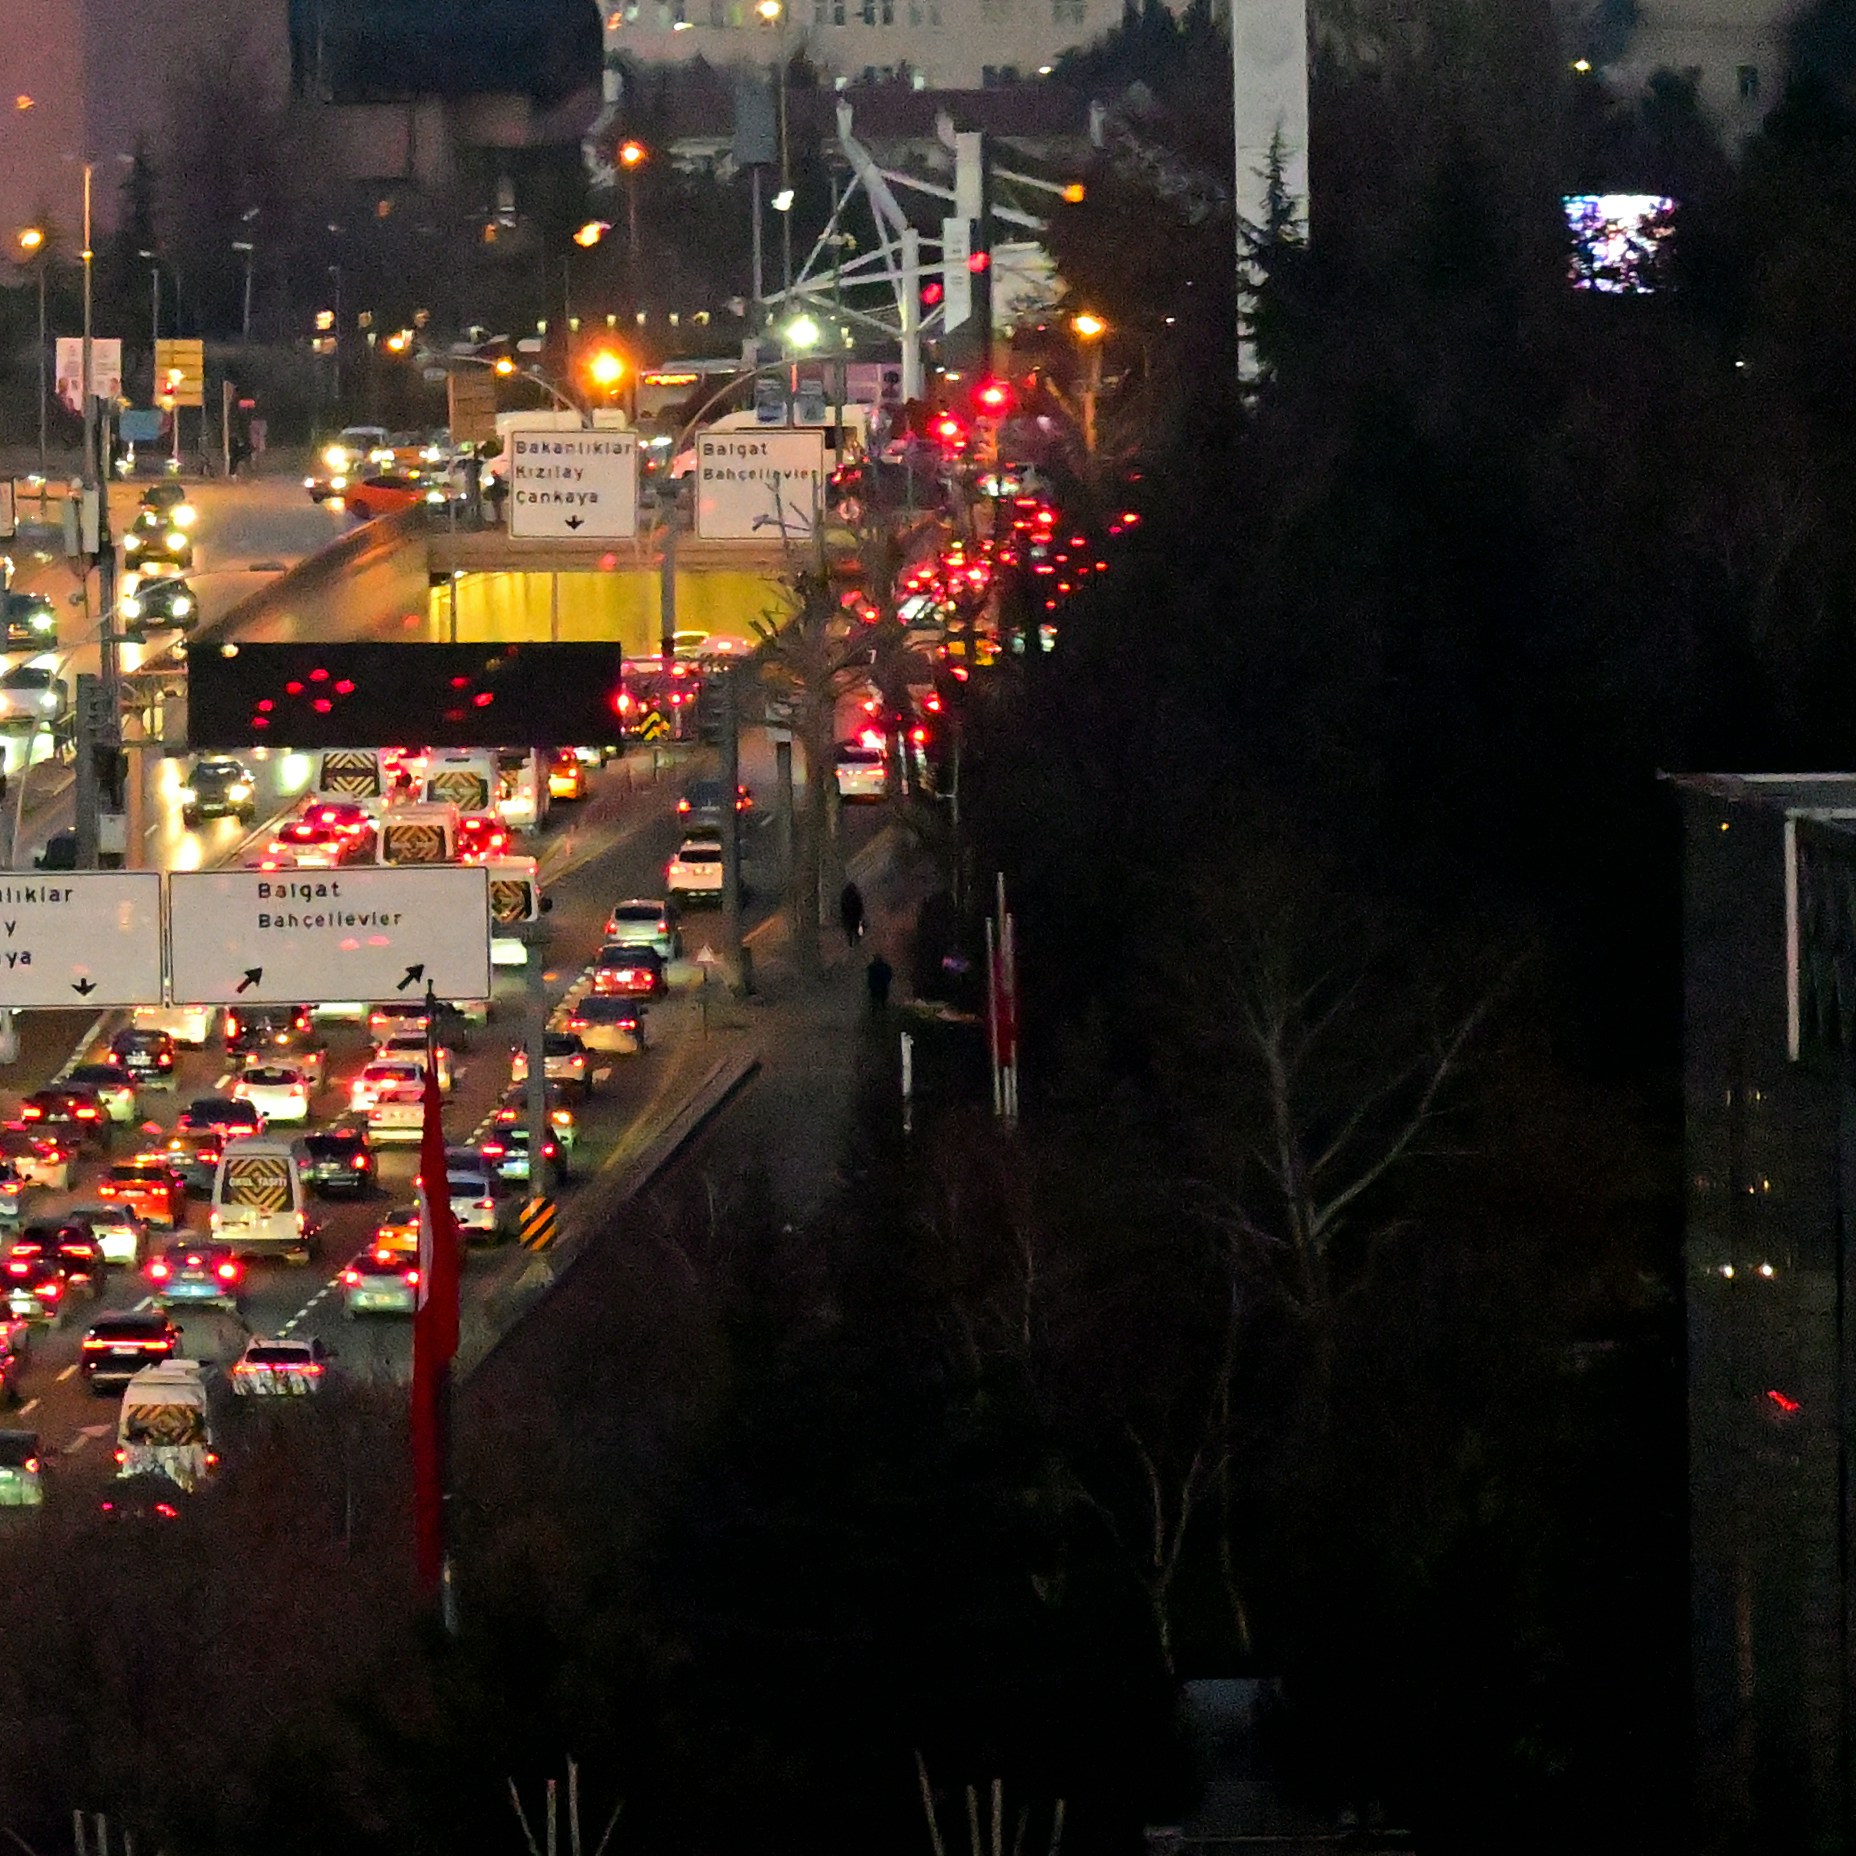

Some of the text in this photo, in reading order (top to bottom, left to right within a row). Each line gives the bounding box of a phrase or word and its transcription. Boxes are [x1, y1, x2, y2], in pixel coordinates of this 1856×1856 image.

[515, 441, 632, 455] Bakanlıklar
[703, 443, 767, 459] Balgat
[515, 466, 584, 481] Kızılay
[515, 490, 599, 506] Çankaya
[258, 881, 341, 902] Balgat
[258, 911, 402, 930] Bahçelievler
